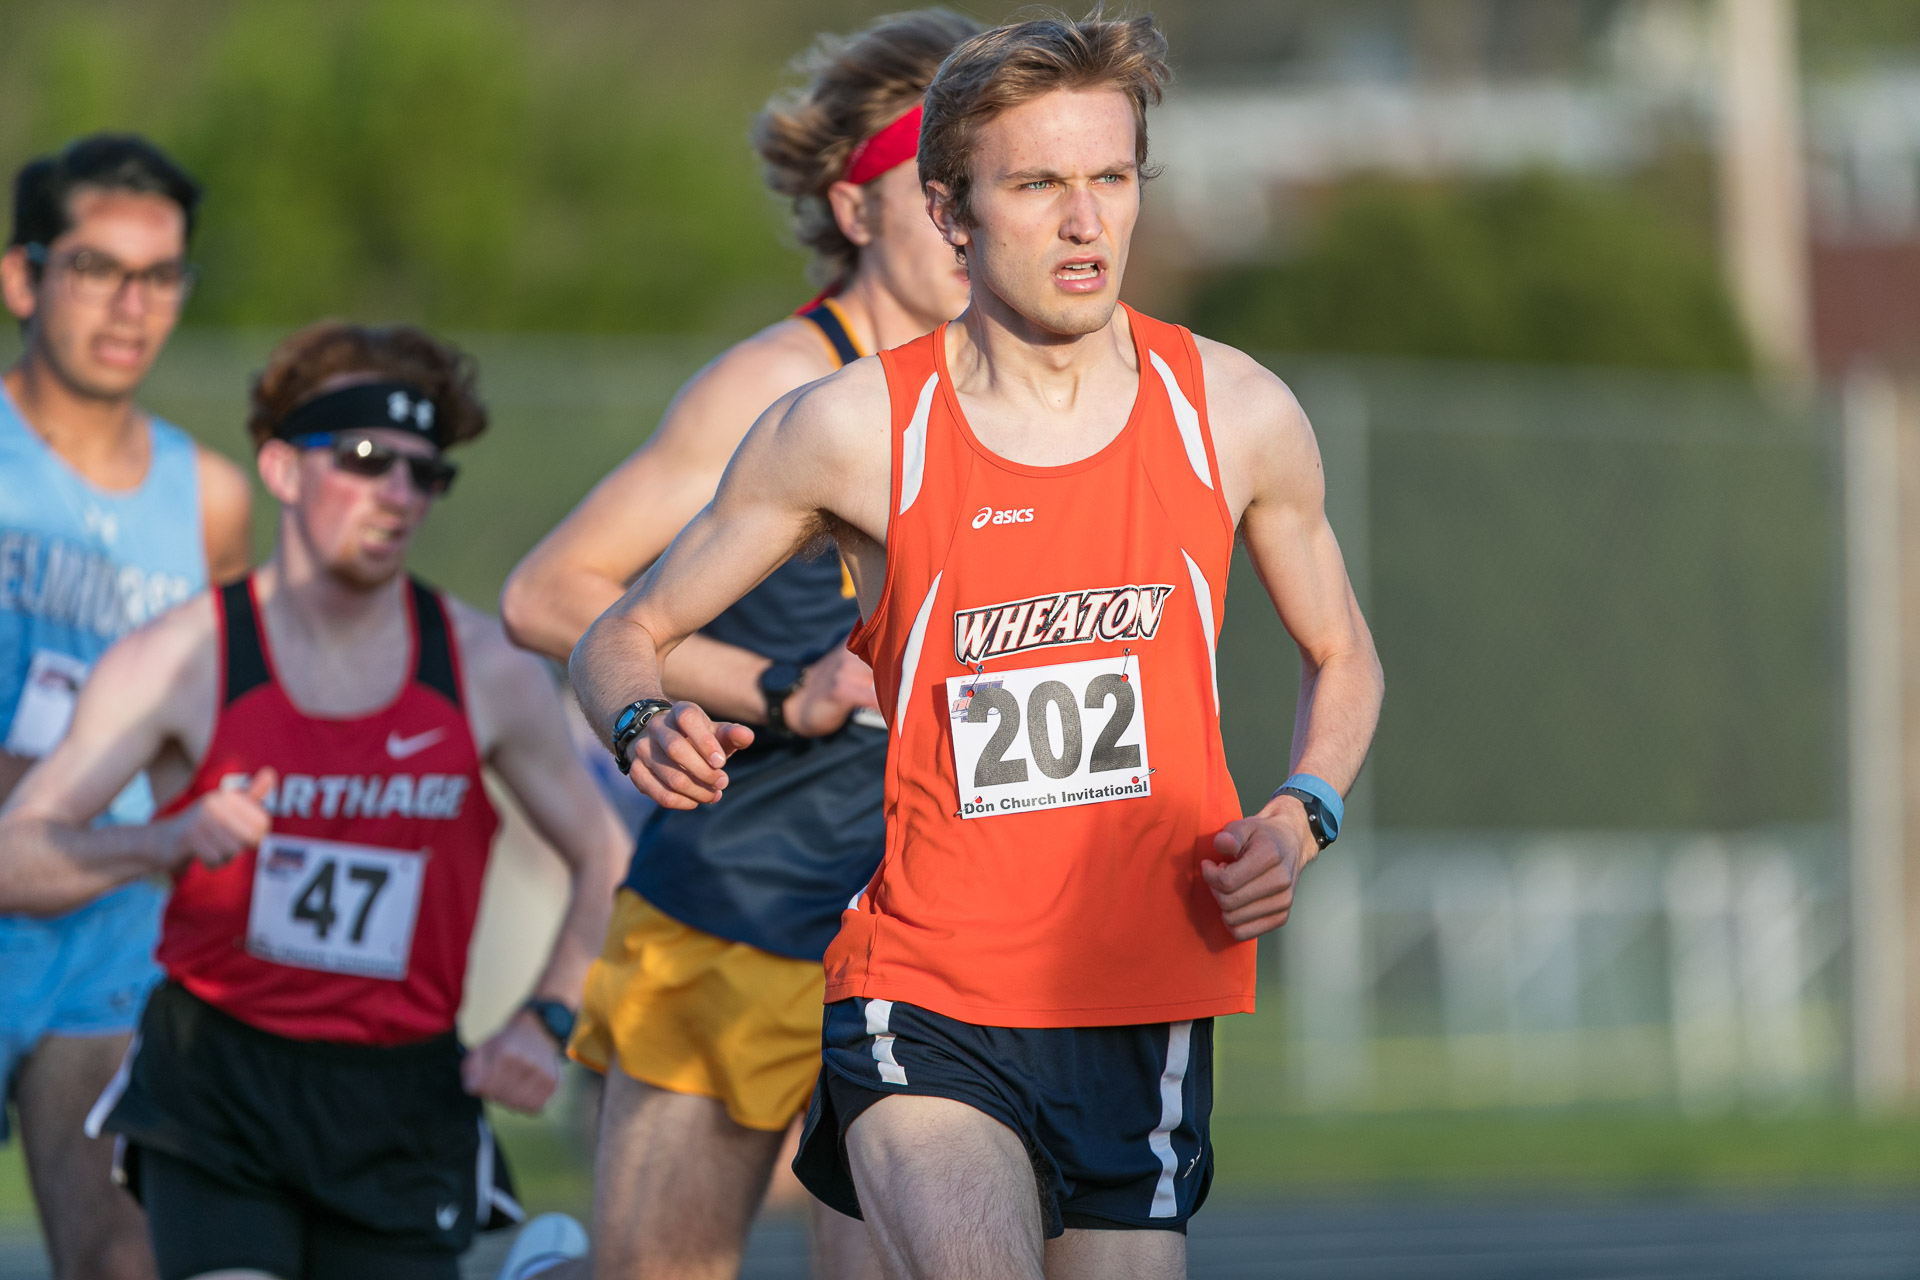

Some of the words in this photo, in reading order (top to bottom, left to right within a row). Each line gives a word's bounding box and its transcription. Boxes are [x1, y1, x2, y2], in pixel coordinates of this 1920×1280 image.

[991, 507, 1035, 525] asics
[955, 585, 1173, 664] WHEATON
[967, 673, 1142, 788] 202
[219, 772, 469, 820] RTHAGE
[964, 802, 995, 815] Don
[999, 792, 1057, 811] Church
[1062, 780, 1148, 802] Invitational
[292, 858, 390, 944] 47
